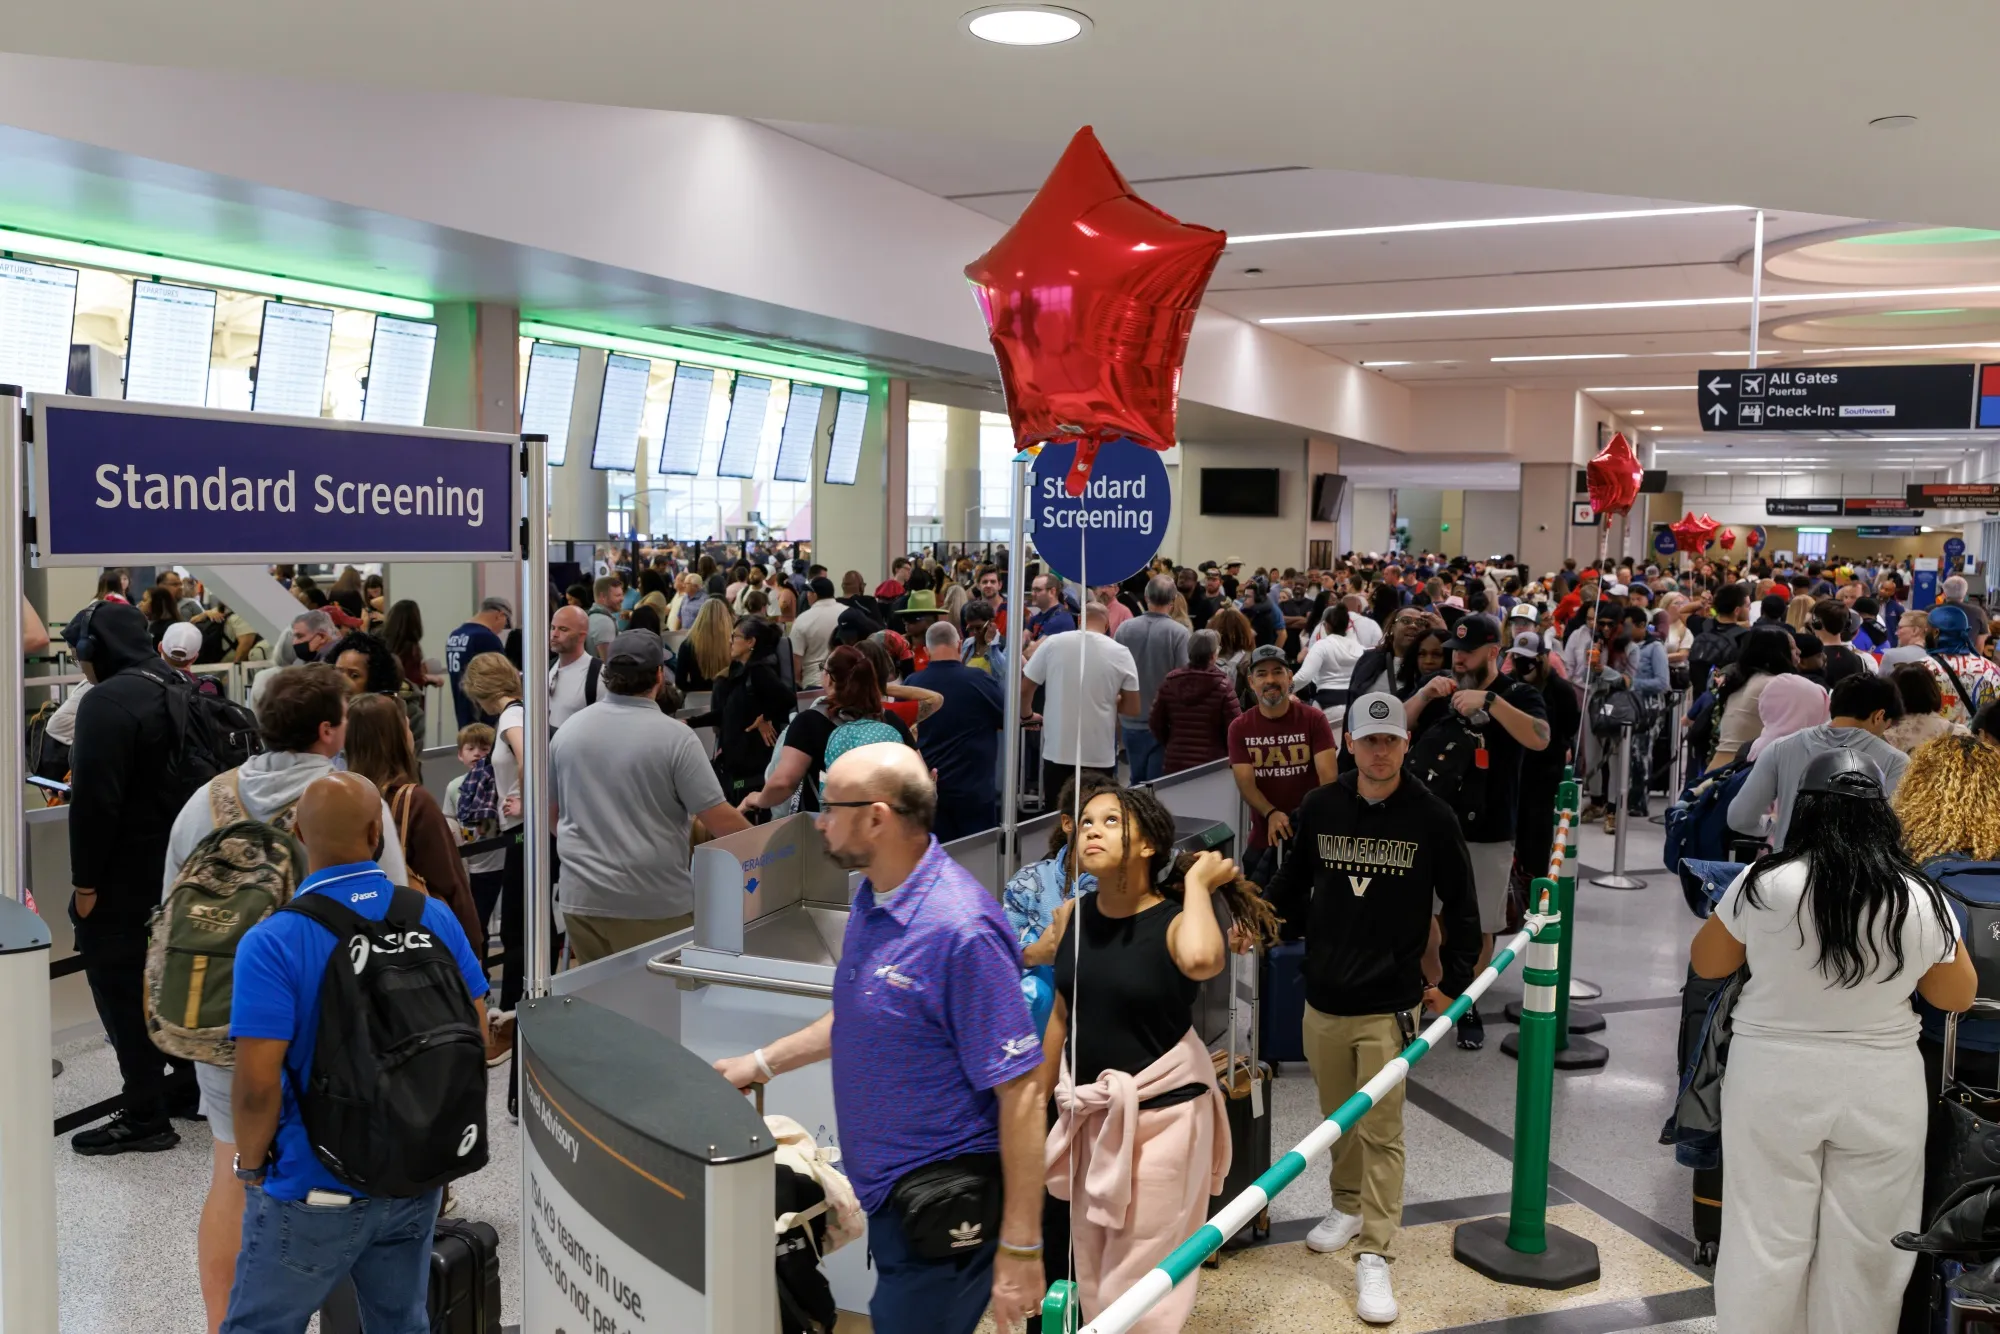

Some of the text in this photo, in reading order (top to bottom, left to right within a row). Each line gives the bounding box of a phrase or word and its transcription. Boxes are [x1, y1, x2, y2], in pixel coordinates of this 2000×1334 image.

[138, 285, 179, 299] DEPARTURES
[1769, 373, 1838, 385] All Gates
[1768, 387, 1807, 397] Puertas
[1766, 404, 1886, 417] Check-In: Southwest
[95, 463, 485, 527] Standard Screening
[1043, 475, 1147, 499] Stndard
[1043, 504, 1153, 536] Screening
[448, 652, 461, 673] 16
[1245, 733, 1306, 746] TEXAS STATE
[1247, 743, 1311, 768] DAD
[1255, 765, 1309, 777] NIVERSITY
[1317, 833, 1418, 868] VANDERBILT
[1325, 861, 1405, 876] COMMODORES
[358, 890, 378, 901] asics
[1348, 875, 1373, 897] V
[526, 1073, 580, 1163] Travel Advisory
[530, 1170, 544, 1215] TSA
[543, 1195, 556, 1233] K9
[557, 1217, 593, 1277] teams
[595, 1254, 609, 1293] in
[613, 1278, 646, 1323] use.
[530, 1213, 618, 1334] Please do not pet
